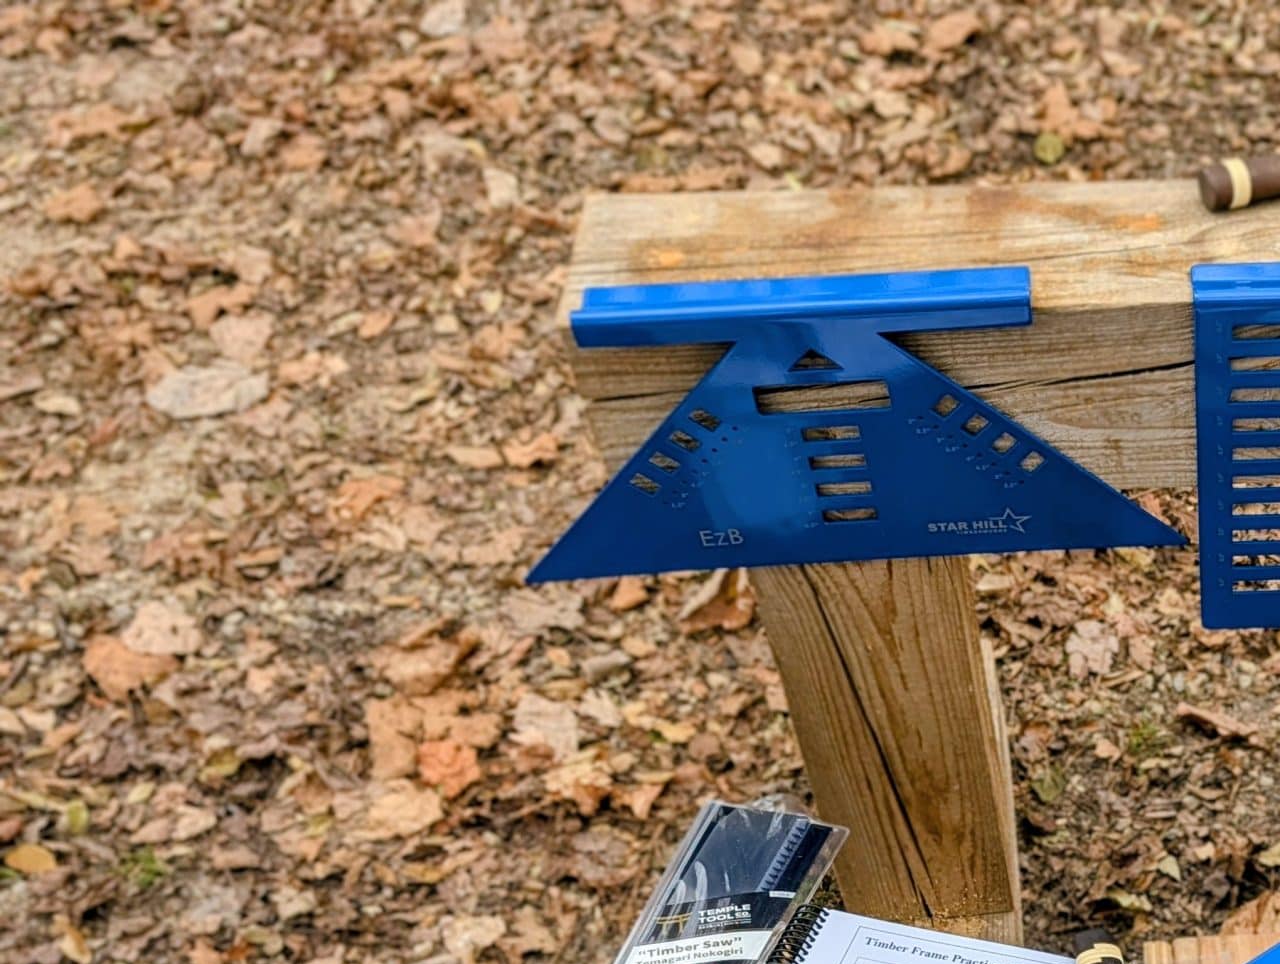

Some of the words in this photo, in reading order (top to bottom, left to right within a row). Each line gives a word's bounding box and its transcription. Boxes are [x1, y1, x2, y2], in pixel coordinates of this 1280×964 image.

[927, 521, 969, 533] STAR
[972, 518, 1008, 531] HILL
[699, 529, 744, 547] EzB
[698, 903, 751, 918] TEMPLE
[698, 912, 734, 924] TOOL
[692, 946, 744, 961] Nokogiri
[864, 936, 909, 954] Timber
[911, 946, 950, 962] Frame
